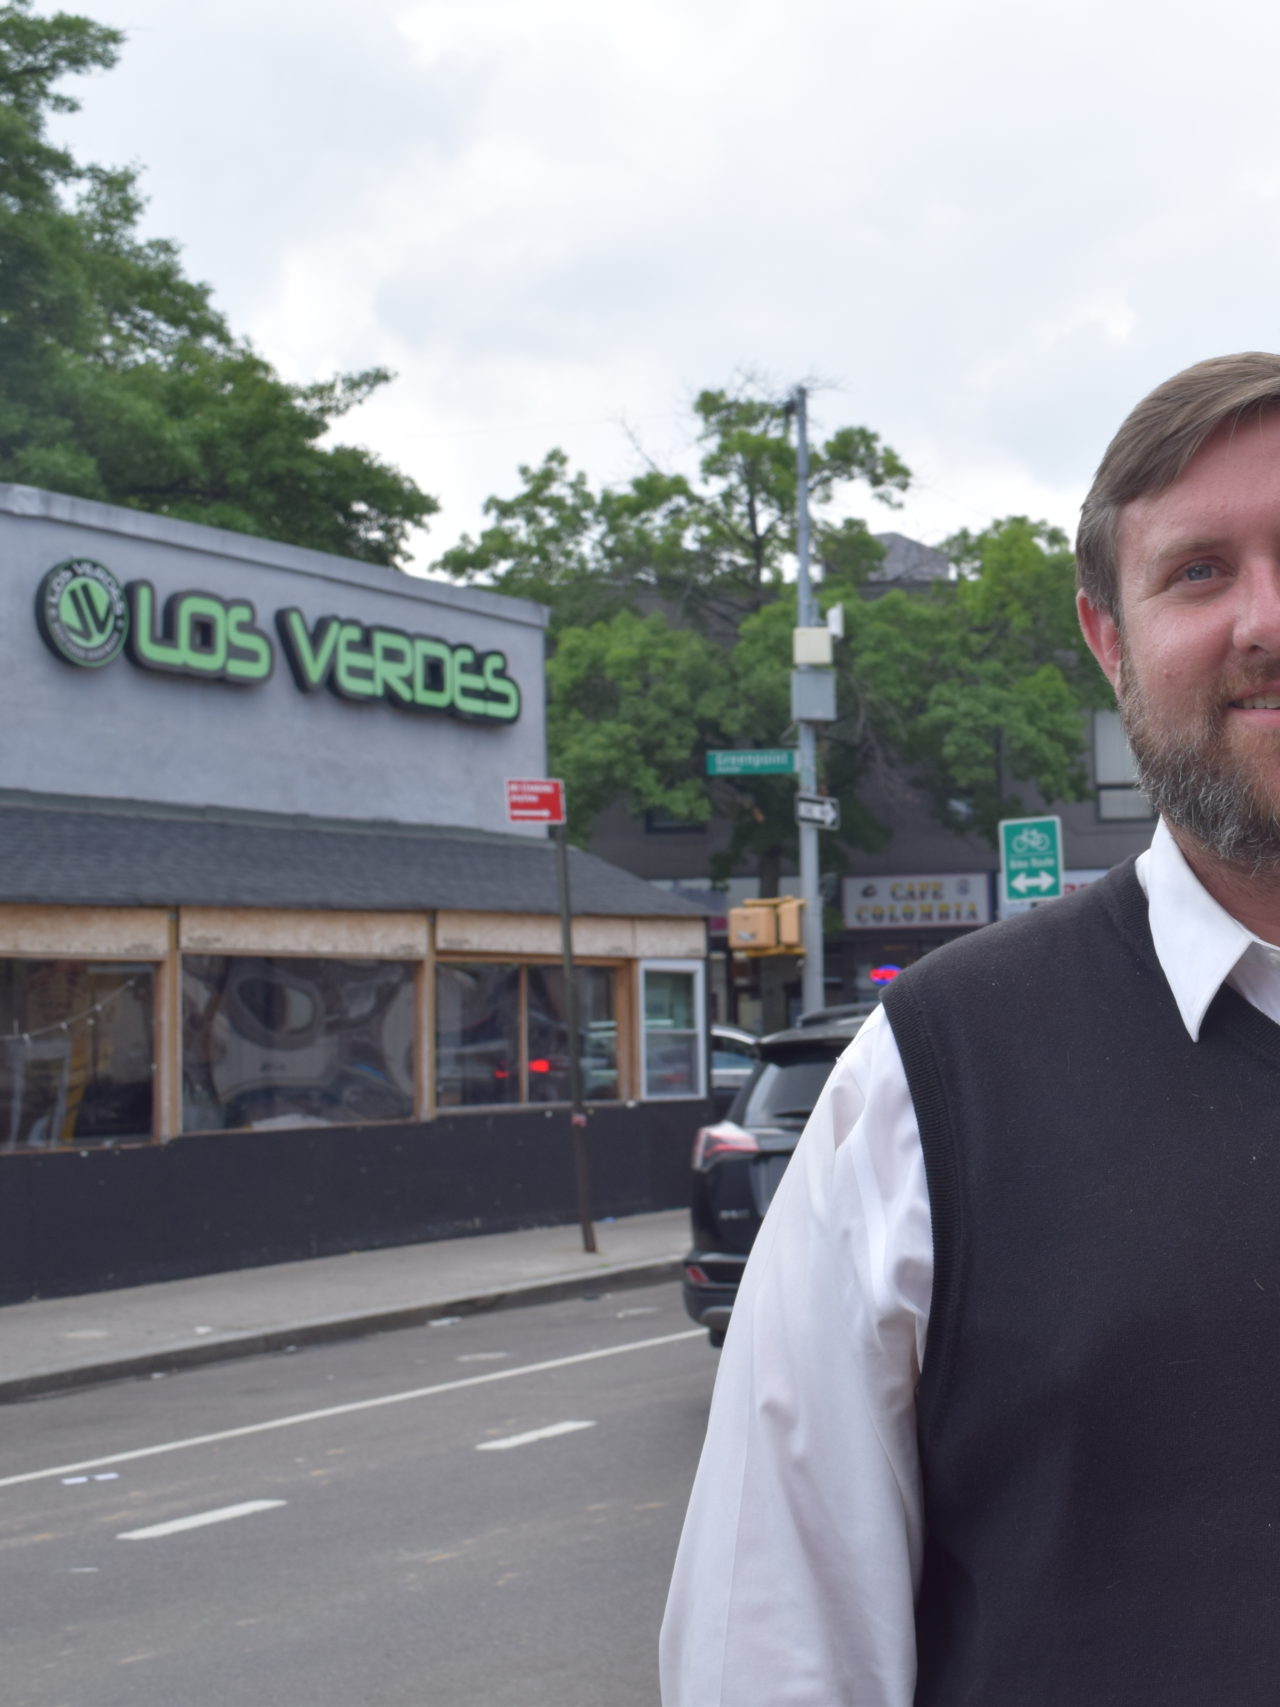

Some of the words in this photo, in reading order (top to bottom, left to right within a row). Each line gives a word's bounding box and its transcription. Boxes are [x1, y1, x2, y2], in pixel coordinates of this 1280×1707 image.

[130, 582, 273, 681] LOS
[282, 608, 520, 722] VERDES
[714, 752, 788, 768] Greenpoint
[889, 881, 945, 901] CAFE
[855, 902, 978, 922] COLOMBIA
